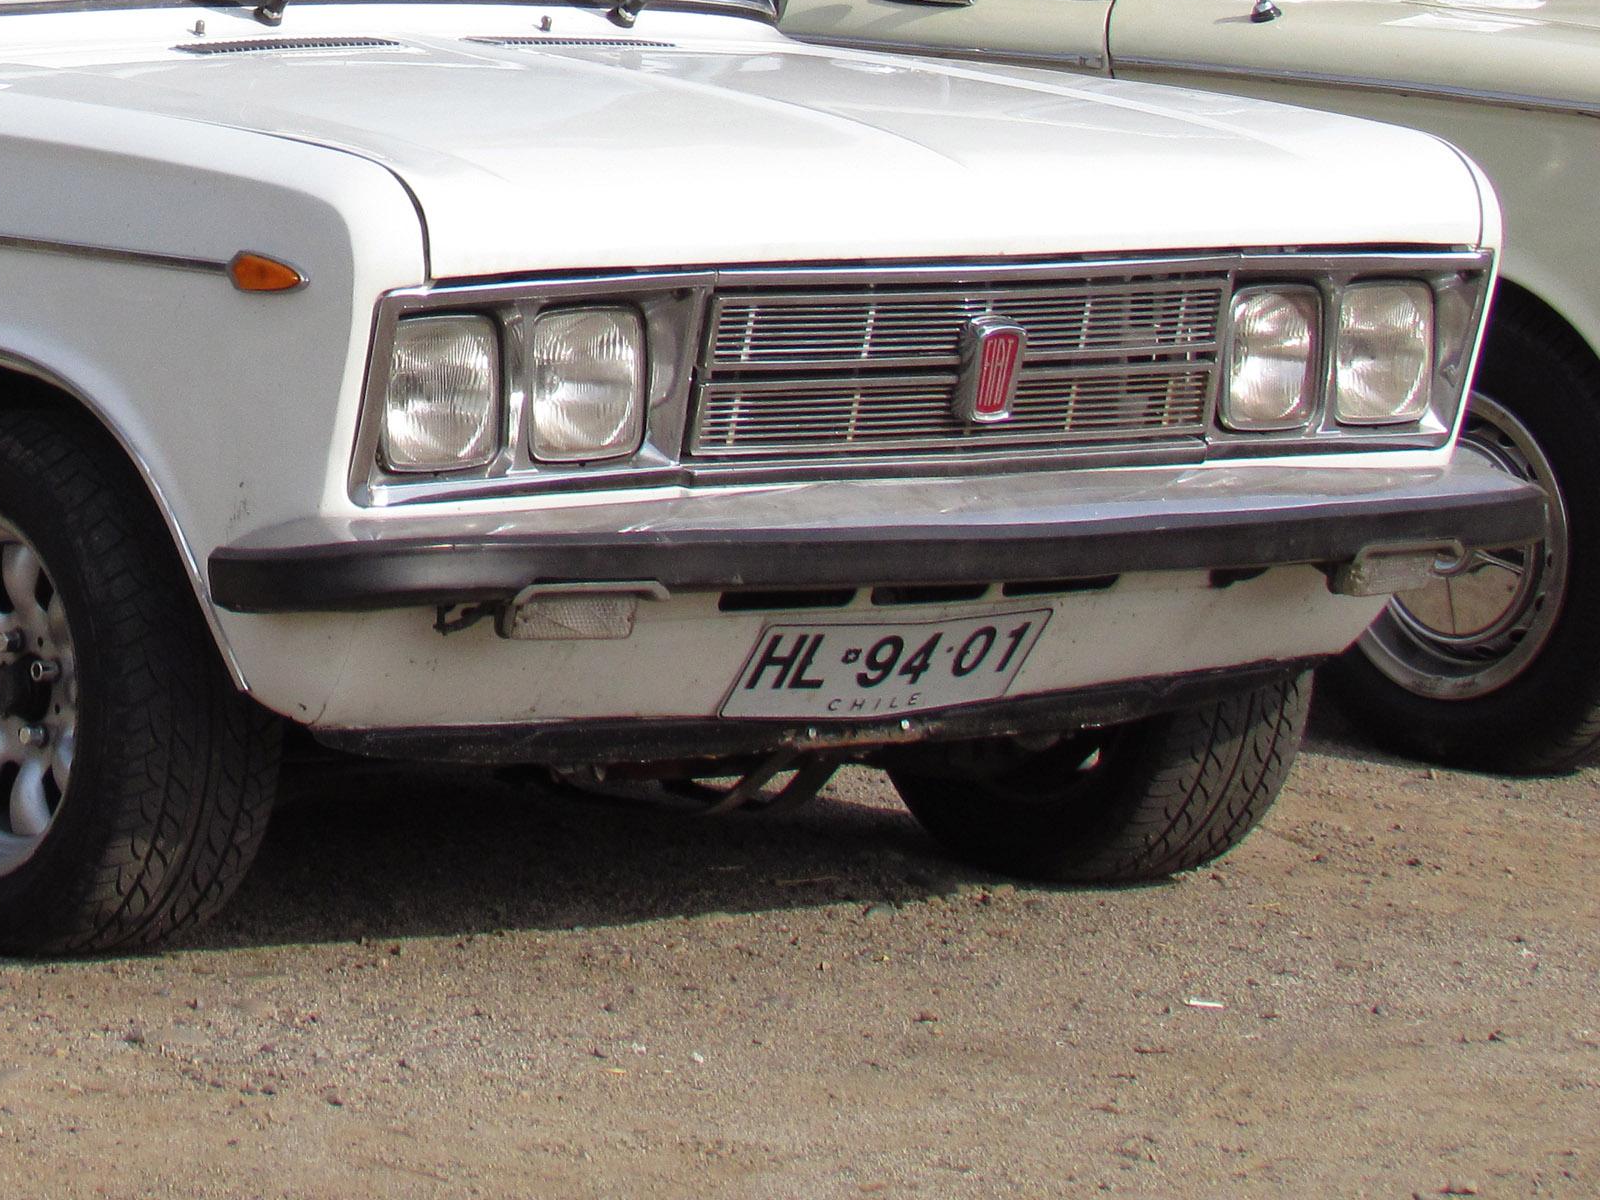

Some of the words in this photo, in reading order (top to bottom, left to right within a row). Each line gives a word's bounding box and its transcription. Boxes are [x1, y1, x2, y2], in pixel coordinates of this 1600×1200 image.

[978, 337, 1015, 406] FIAT
[744, 632, 826, 690] HL
[827, 692, 922, 712] CHILE
